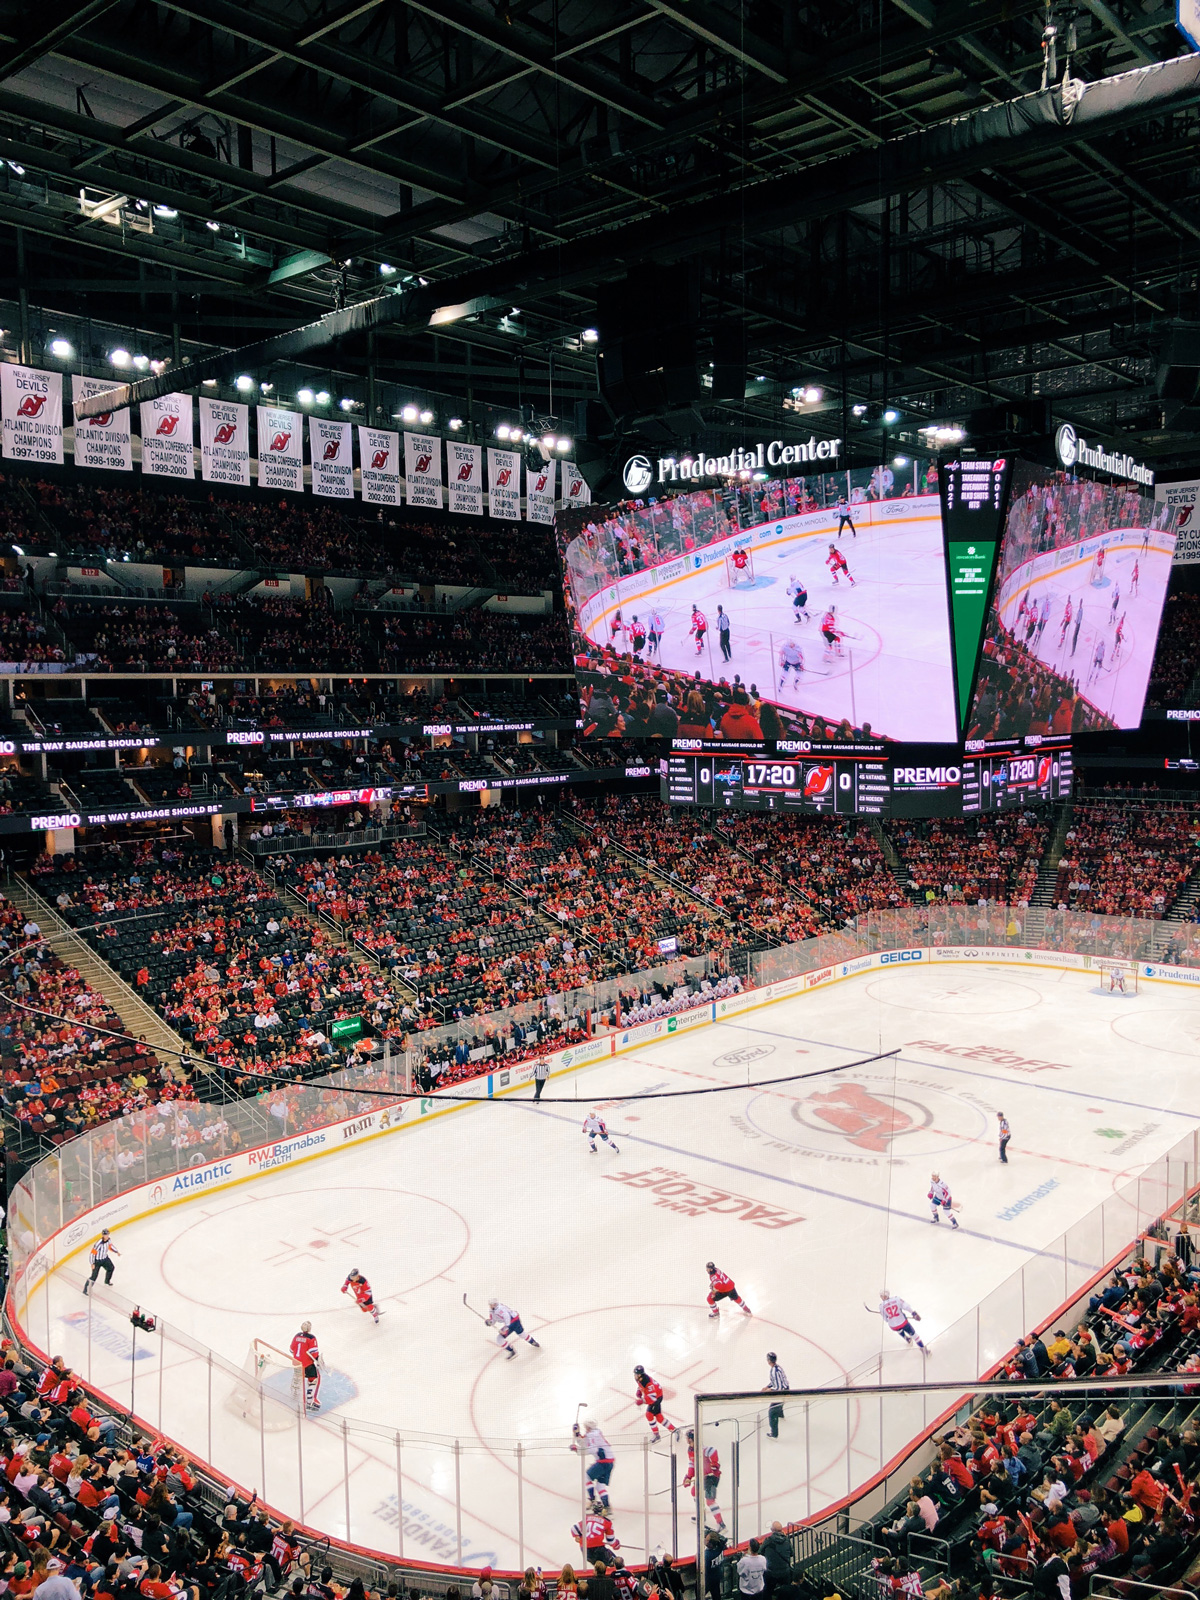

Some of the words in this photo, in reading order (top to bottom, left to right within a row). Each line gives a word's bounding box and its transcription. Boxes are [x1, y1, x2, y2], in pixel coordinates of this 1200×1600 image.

[13, 370, 26, 378] NEW
[28, 373, 50, 382] JERSEY
[16, 379, 48, 392] DEVILS
[154, 400, 180, 413] DEVILS
[221, 404, 238, 413] JERSEY
[212, 410, 237, 422] DEVILS
[4, 418, 32, 432] ATLANTIC
[34, 422, 62, 436] DIVISION
[268, 419, 292, 430] DEVILS
[14, 434, 52, 449] CHAMPIONS
[76, 428, 104, 441] ATLANTIC
[106, 432, 130, 444] DIVISION
[320, 430, 342, 440] DEVILS
[86, 442, 122, 456] CHAMPIONS
[144, 438, 164, 450] EASTERN
[165, 440, 192, 454] CONFERENCE
[370, 438, 390, 448] DEVILS
[414, 443, 432, 454] DEVILS
[11, 447, 56, 460] 1997-1998
[151, 450, 187, 465] CHAMPIONS
[203, 446, 226, 458] ATLANTIC
[228, 449, 248, 460] DIVISION
[456, 452, 474, 462] DEVILS
[658, 444, 764, 482] Prudential
[767, 436, 842, 465] Center
[84, 456, 125, 467] 1998-1999
[212, 459, 242, 472] CHAMPIONS
[260, 453, 276, 464] EASTERN
[278, 455, 302, 468] CONFERENCE
[496, 458, 512, 468] DEVILS
[960, 462, 976, 470] TEAM
[976, 462, 991, 470] STATS
[1078, 438, 1127, 478] Prudential
[1127, 456, 1154, 485] Center
[151, 464, 188, 476] 1999-2000
[265, 466, 297, 478] CHAMPIONS
[314, 462, 334, 472] ATLANTIC
[334, 465, 352, 475] DIVISION
[211, 470, 244, 482] 2000-2001
[320, 474, 346, 486] CHAMPIONS
[363, 470, 377, 480] EASTERN
[378, 472, 400, 484] CONFERENCE
[266, 478, 296, 488] 2000-2001
[368, 482, 396, 494] CHAMPIONS
[317, 484, 350, 496] 2002-2003
[1178, 486, 1200, 494] JERSEY
[368, 492, 396, 502] 2002-2003
[412, 496, 438, 506] 2005-2006
[1168, 494, 1196, 504] DEVILS
[704, 544, 732, 563] Prudential
[1166, 710, 1200, 718] PREMIO
[423, 724, 451, 734] PREMIO
[226, 732, 264, 742] PREMIO
[672, 739, 702, 748] PREMIO
[1024, 735, 1042, 745] PREMIO
[42, 742, 64, 750] WAY
[65, 740, 106, 750] SAUSAGE
[108, 739, 142, 747] SHOULD
[776, 741, 811, 750] PREMIO
[965, 740, 985, 750] PREMIO
[625, 767, 650, 776] PREMIO
[700, 768, 710, 782] 0
[748, 765, 795, 784] 17:20
[840, 773, 850, 789] 0
[893, 767, 960, 783] PREMIO
[983, 770, 989, 786] 0
[1010, 760, 1034, 780] 17:20
[1053, 762, 1058, 776] 0
[459, 780, 488, 790] PREMIO
[334, 792, 350, 801] 17:20
[31, 814, 80, 829] PREMIO
[88, 815, 106, 823] THE
[108, 812, 128, 821] WAY
[130, 809, 170, 820] SAUSAGE
[172, 806, 205, 816] SHOULD
[880, 950, 922, 964] GEICO
[1034, 953, 1078, 964] investorsBank
[850, 958, 872, 972] Prudential
[1159, 968, 1200, 981] Prudentia
[727, 995, 756, 1009] investorsBank
[669, 1010, 708, 1028] enterprise
[575, 1046, 586, 1055] EAST
[588, 1042, 602, 1052] COAST
[904, 1040, 1072, 1070] FACE-OFF
[974, 1045, 1016, 1055] NHL
[575, 1053, 590, 1062] POWER
[723, 1048, 768, 1064] Ford
[515, 1065, 532, 1074] STREAM
[850, 1073, 955, 1092] Prudential
[958, 1091, 996, 1114] Center
[730, 1115, 761, 1139] Center
[248, 1134, 326, 1165] RWJBarnabas
[763, 1140, 878, 1166] Prudential
[260, 1153, 292, 1170] HEALTH
[172, 1163, 232, 1192] Atlantic
[650, 1166, 689, 1179] 2018
[601, 1171, 807, 1229] FACE-OFF
[653, 1198, 707, 1217] NHL
[67, 1227, 84, 1245] Ford
[886, 1304, 900, 1320] 92
[296, 1343, 301, 1357] 1
[388, 1494, 471, 1546] SPORTSBOOK
[372, 1501, 457, 1559] FANDUEL
